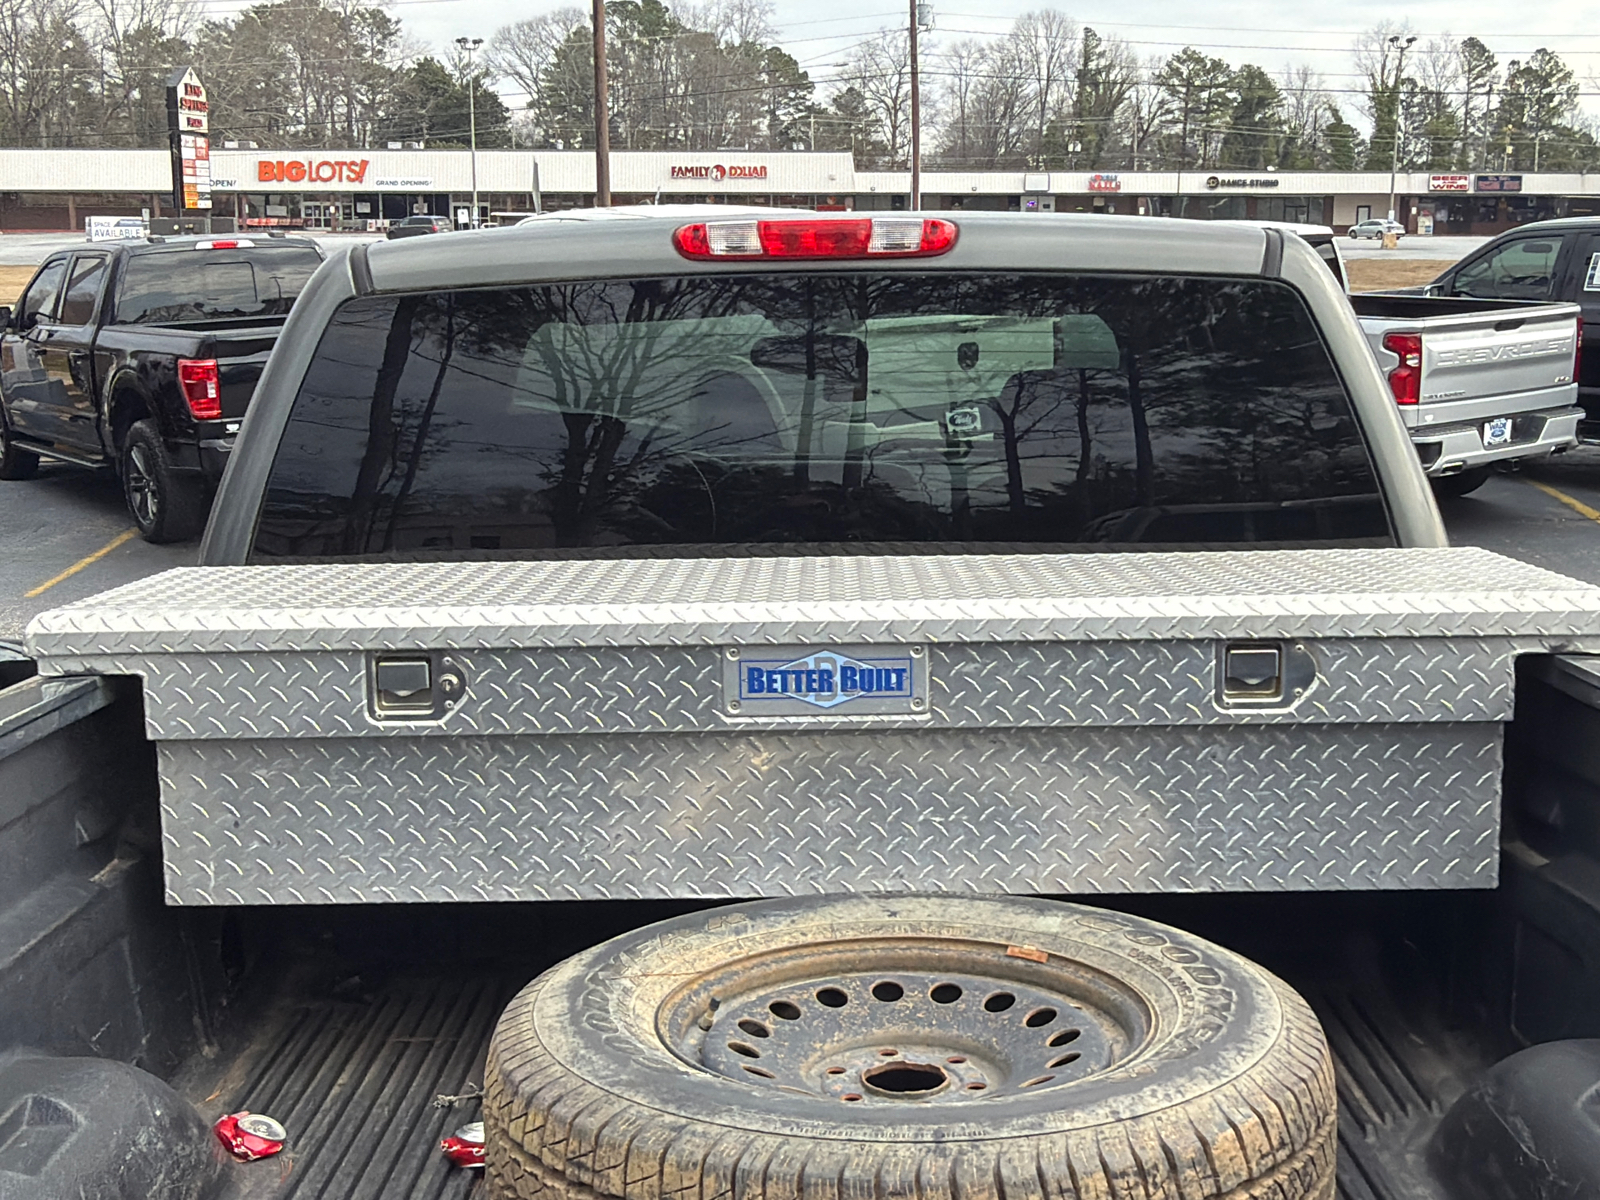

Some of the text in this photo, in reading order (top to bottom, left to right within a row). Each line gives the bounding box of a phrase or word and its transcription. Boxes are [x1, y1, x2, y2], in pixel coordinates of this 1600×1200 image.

[258, 159, 370, 183] BIG LOTS!
[671, 166, 767, 178] FAMILY DOLLAR
[1221, 179, 1247, 187] DANCE
[1250, 179, 1279, 187] STUDIO
[94, 229, 141, 238] AVAILABLE
[1436, 338, 1572, 367] CHEVROLET
[747, 665, 907, 694] BETTER BUILT
